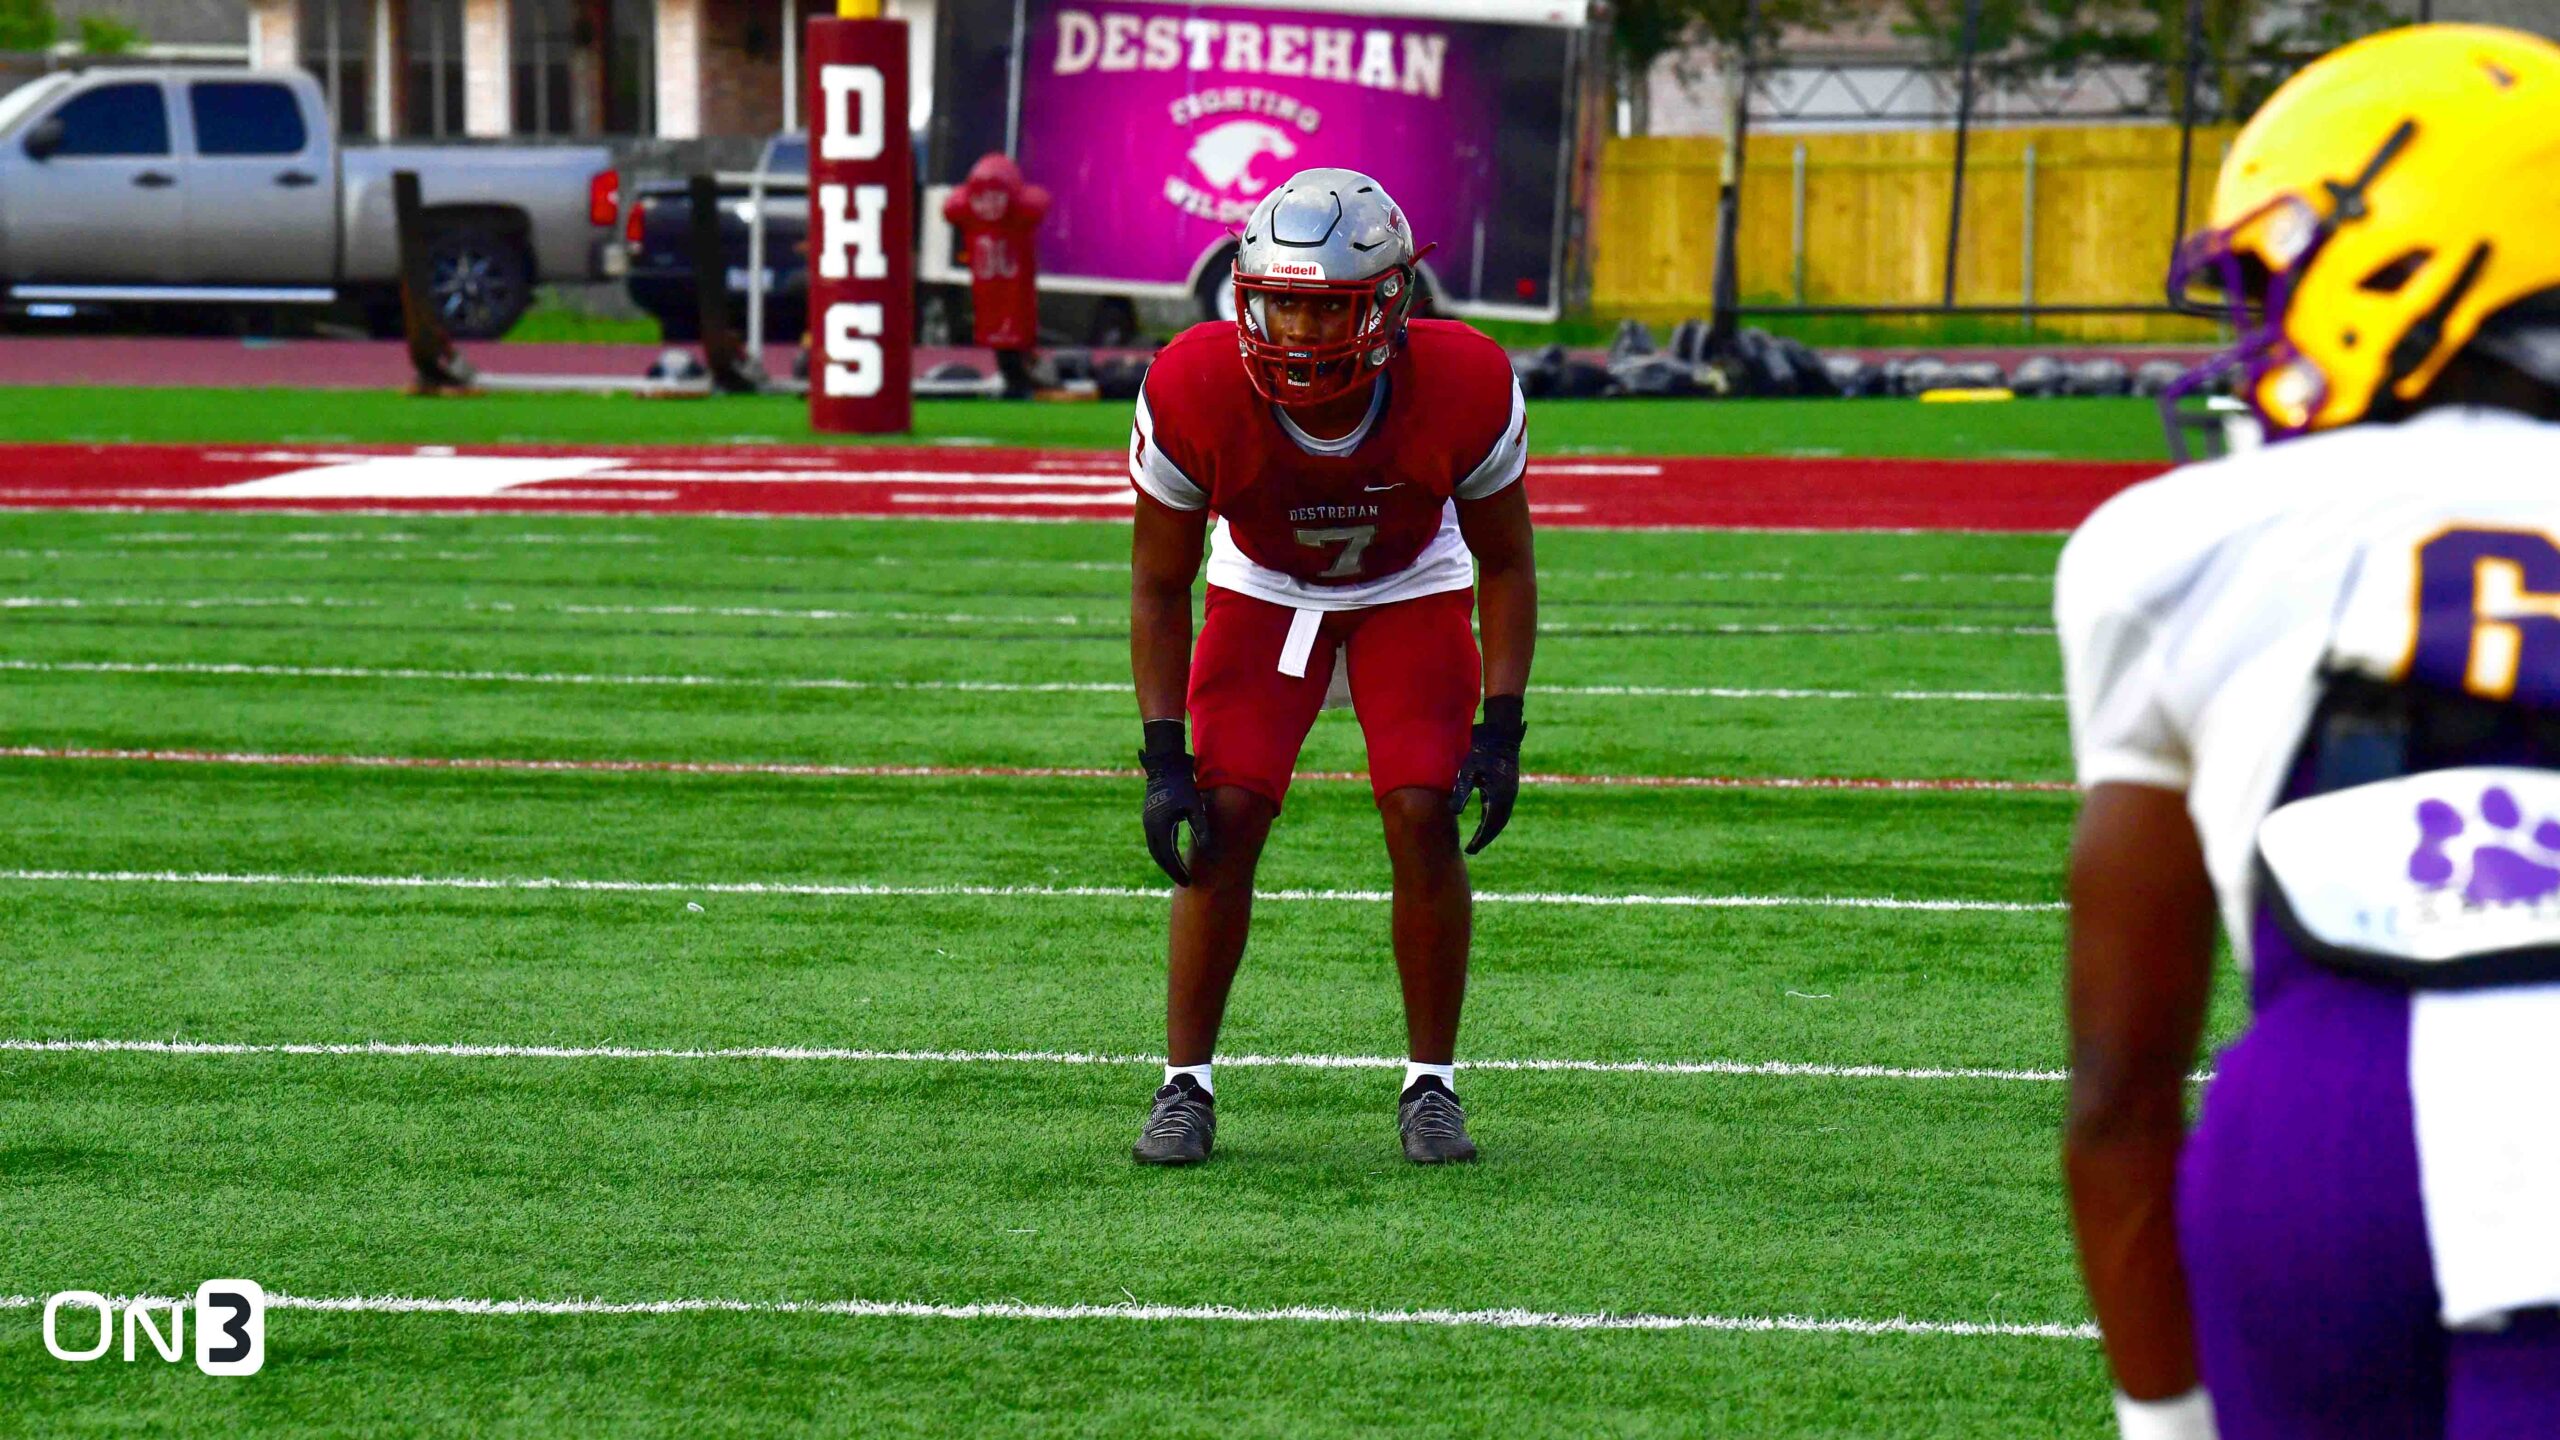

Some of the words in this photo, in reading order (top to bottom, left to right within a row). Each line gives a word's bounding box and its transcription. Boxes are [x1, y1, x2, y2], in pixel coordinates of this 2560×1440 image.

[1053, 10, 1448, 98] DESTREHAN
[1169, 86, 1322, 134] FIGHTING
[1164, 175, 1258, 224] WILDC
[819, 65, 887, 396] DHS
[1272, 263, 1317, 276] Riddell
[1289, 505, 1379, 521] DESTREHAN
[1294, 525, 1377, 578] 7
